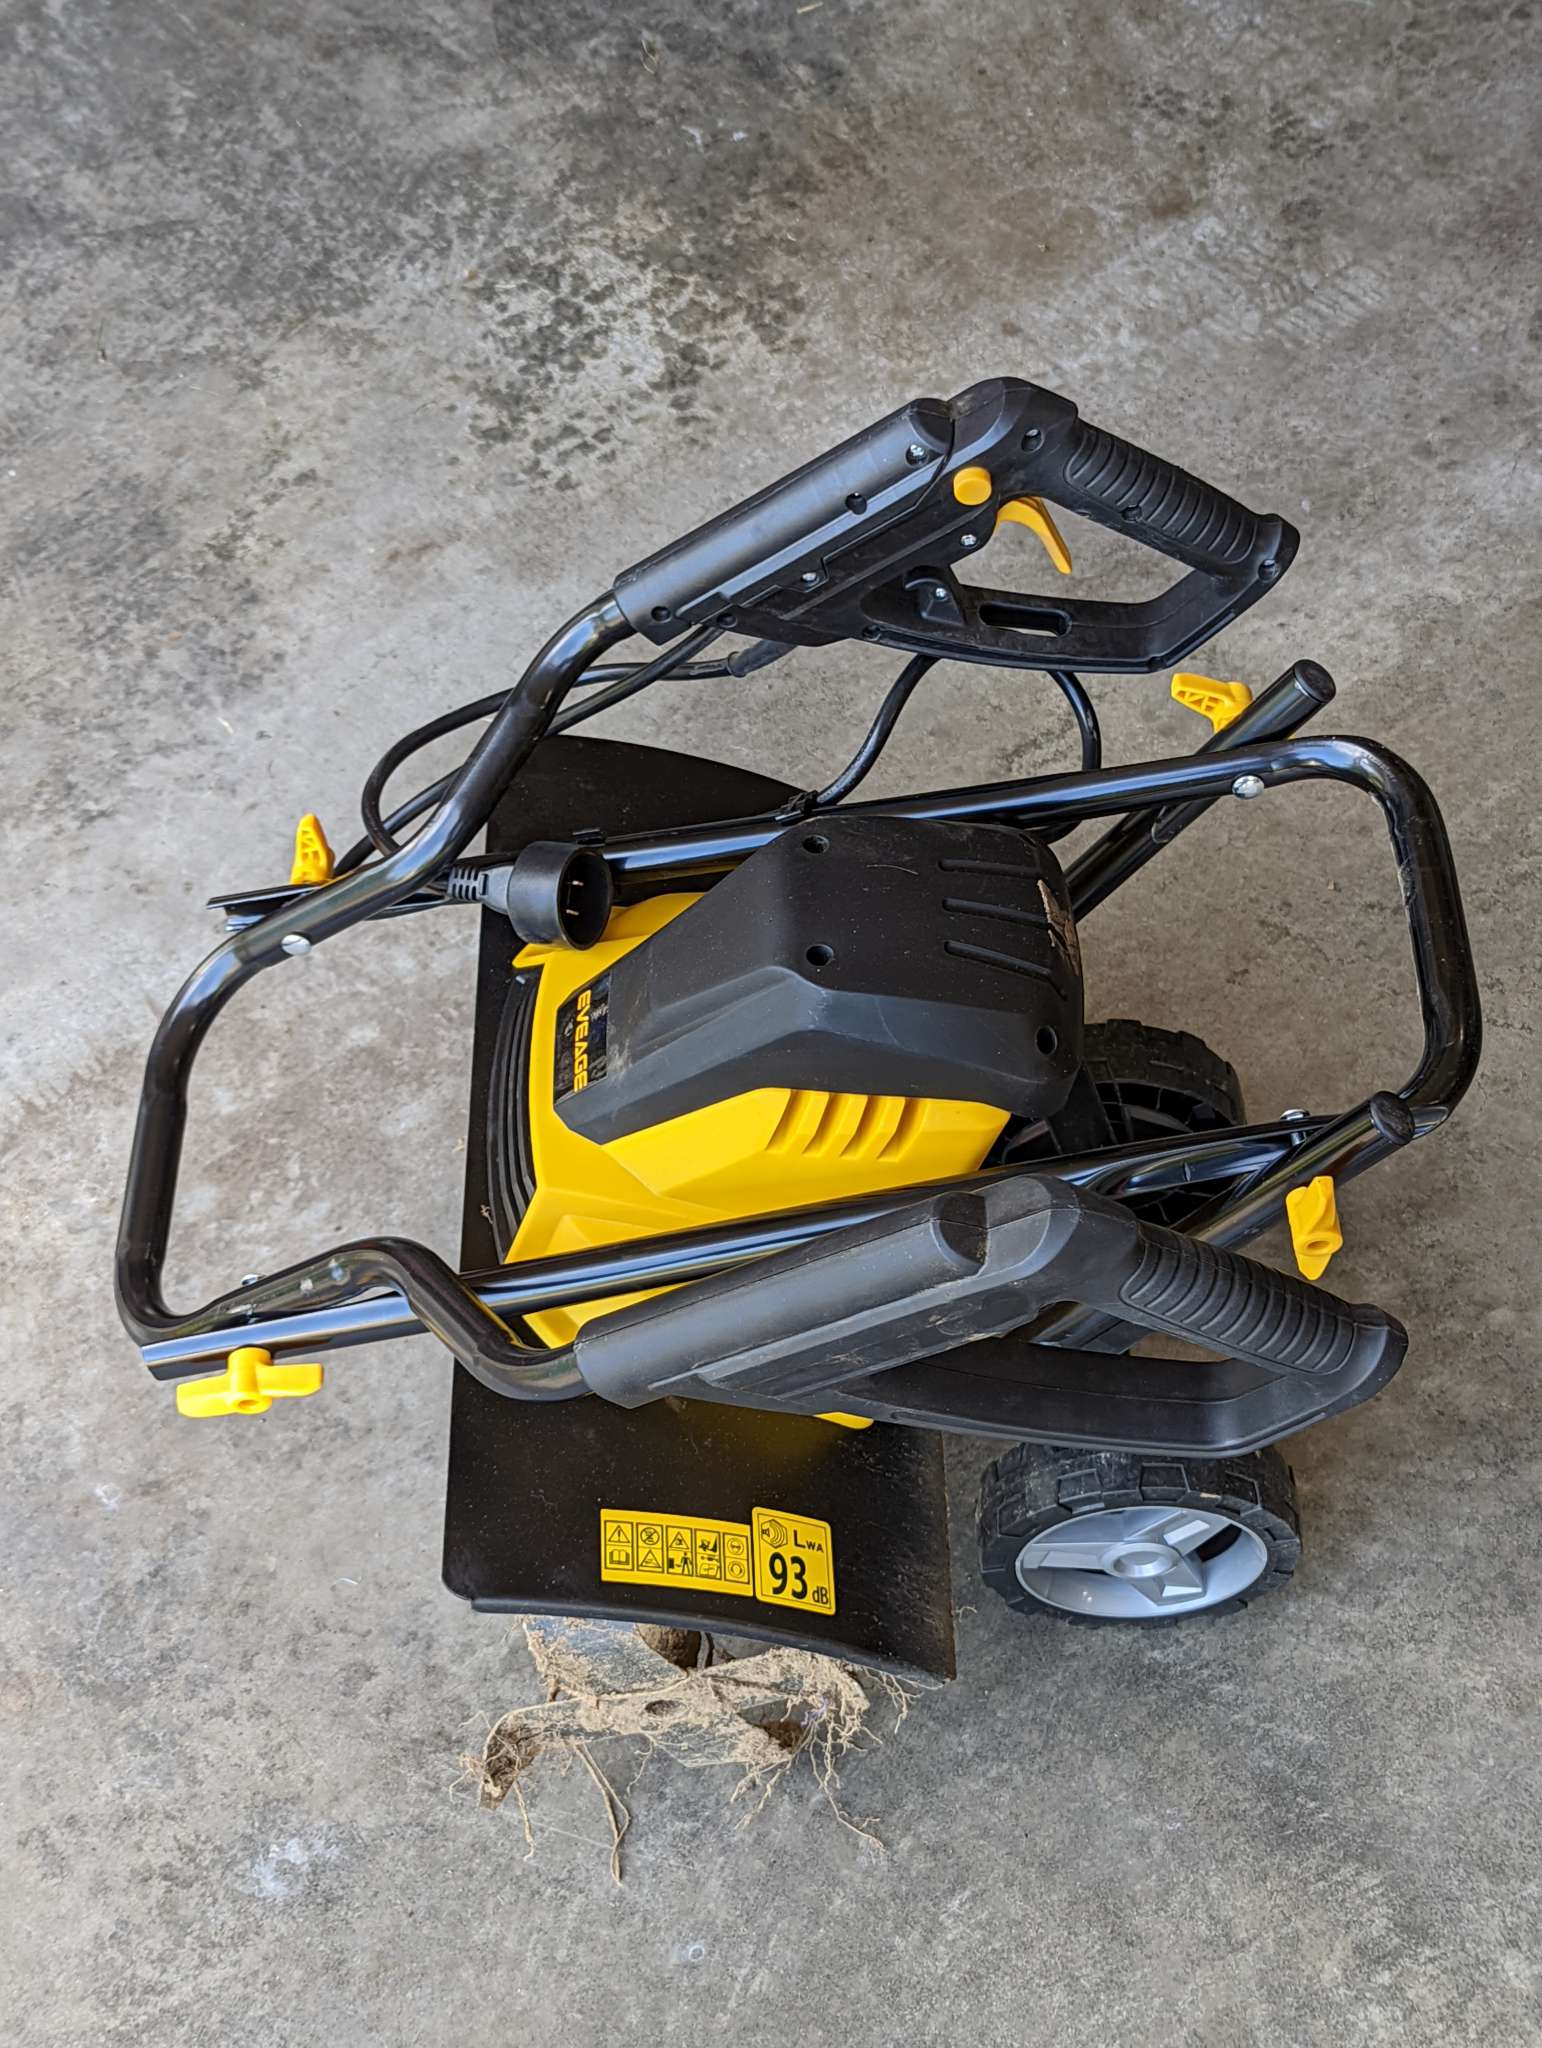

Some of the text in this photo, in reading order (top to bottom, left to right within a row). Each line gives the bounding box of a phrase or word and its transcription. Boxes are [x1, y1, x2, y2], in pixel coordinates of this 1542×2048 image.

[574, 989, 592, 1093] EVEAGE
[769, 1552, 829, 1605] 93 dB
